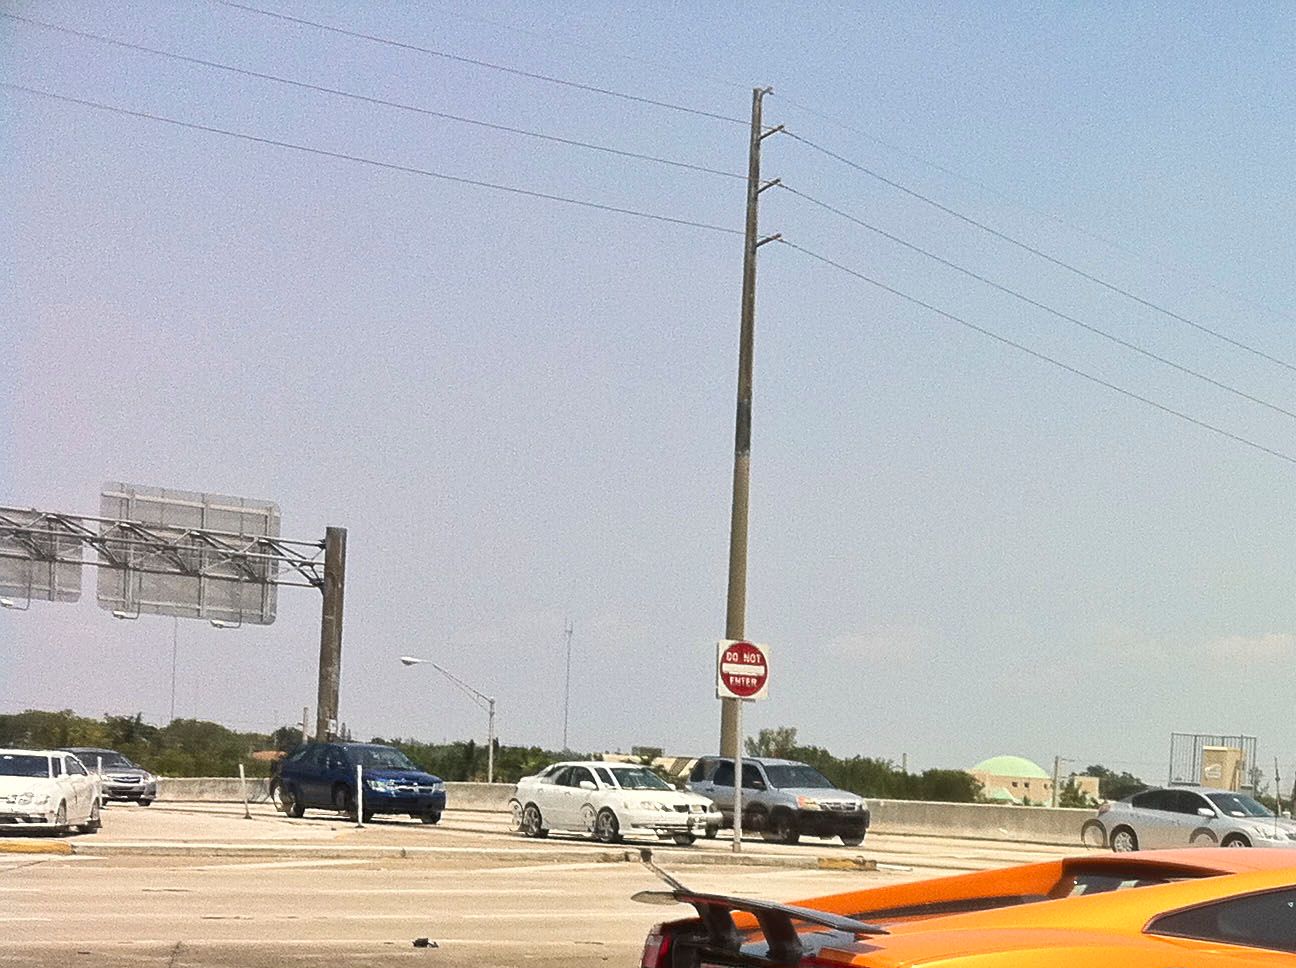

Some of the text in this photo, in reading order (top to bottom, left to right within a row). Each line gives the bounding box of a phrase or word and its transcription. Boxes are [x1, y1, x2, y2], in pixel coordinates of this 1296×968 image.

[725, 651, 762, 664] DO NOT
[729, 675, 758, 688] ENTER
